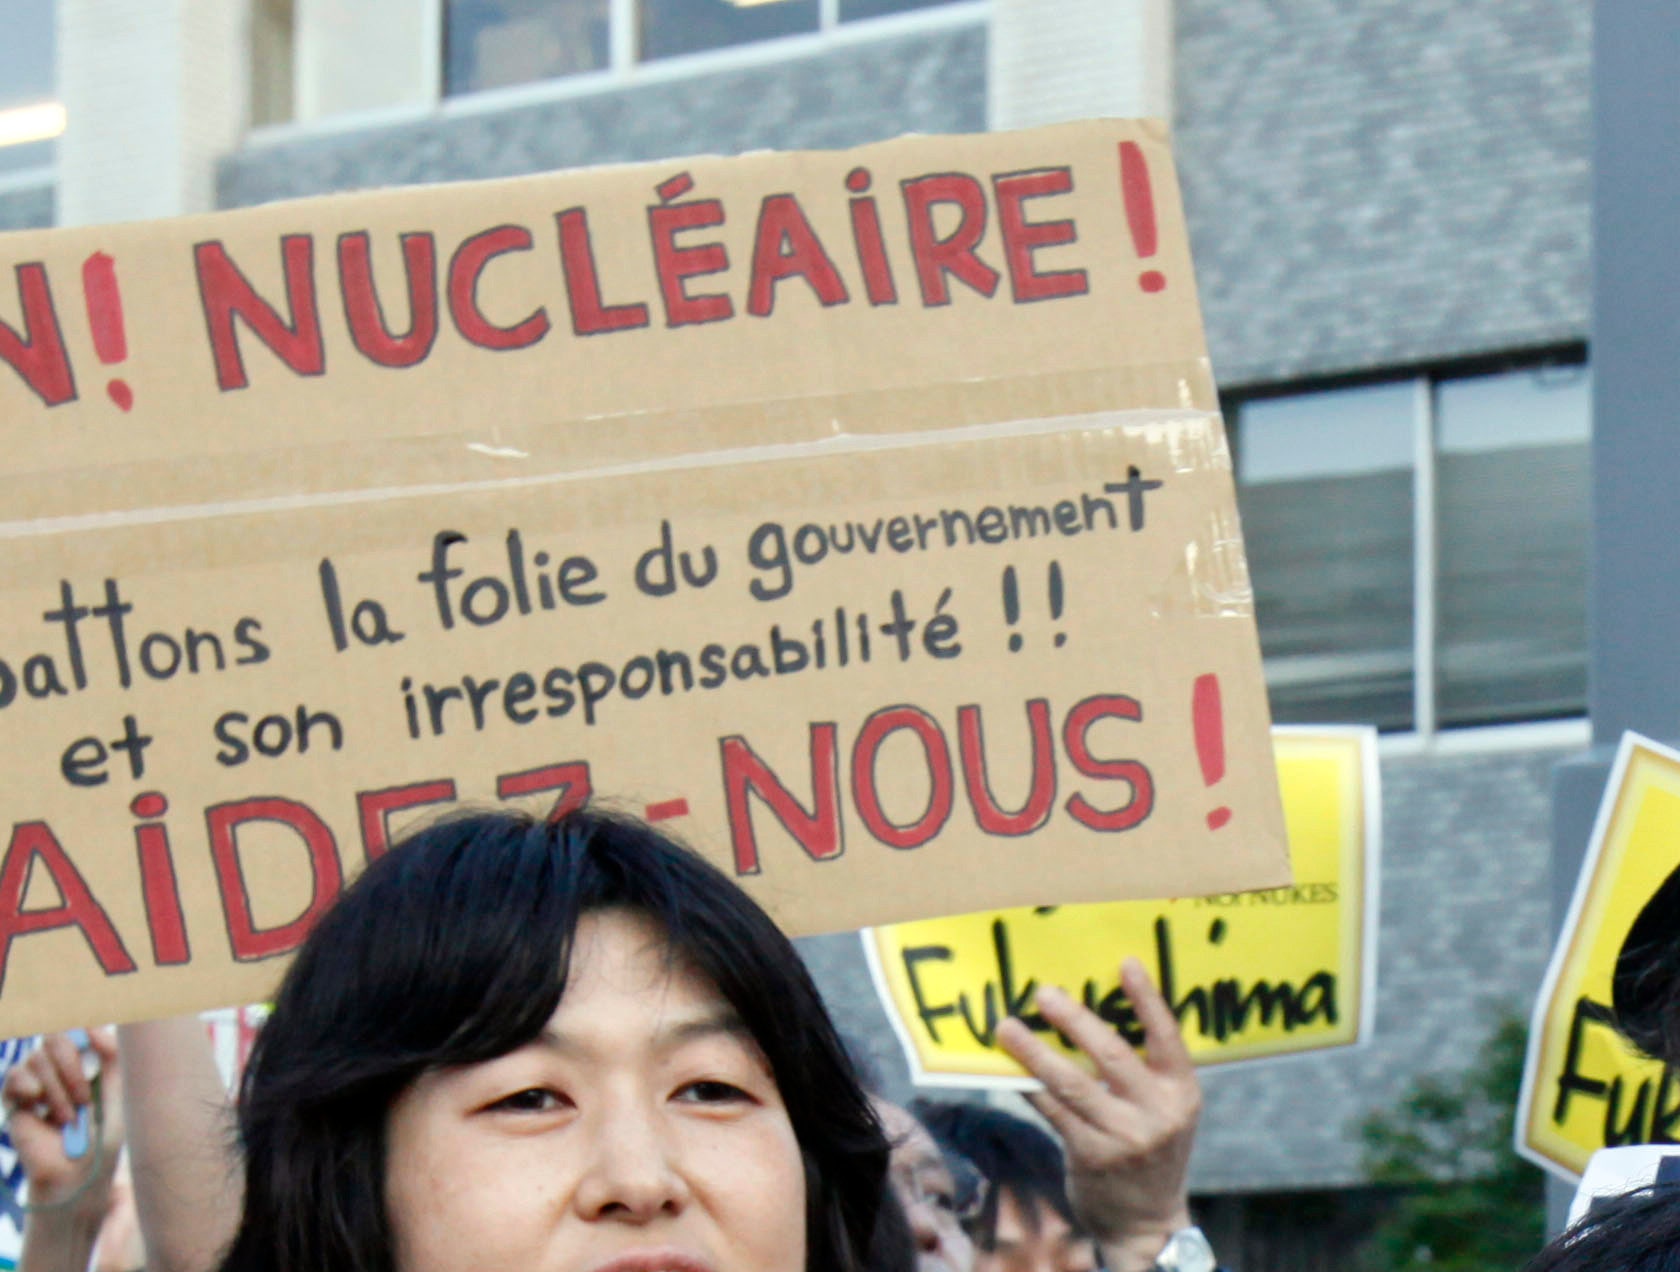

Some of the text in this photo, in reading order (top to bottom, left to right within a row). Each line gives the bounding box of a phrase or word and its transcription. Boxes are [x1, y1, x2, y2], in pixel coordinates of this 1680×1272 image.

[319, 557, 405, 652] la
[418, 528, 607, 629] folie
[635, 519, 718, 597] du
[747, 465, 1163, 601] gouvernement
[60, 716, 152, 786] et
[213, 704, 344, 766] son
[401, 587, 963, 739] irresponsabilité
